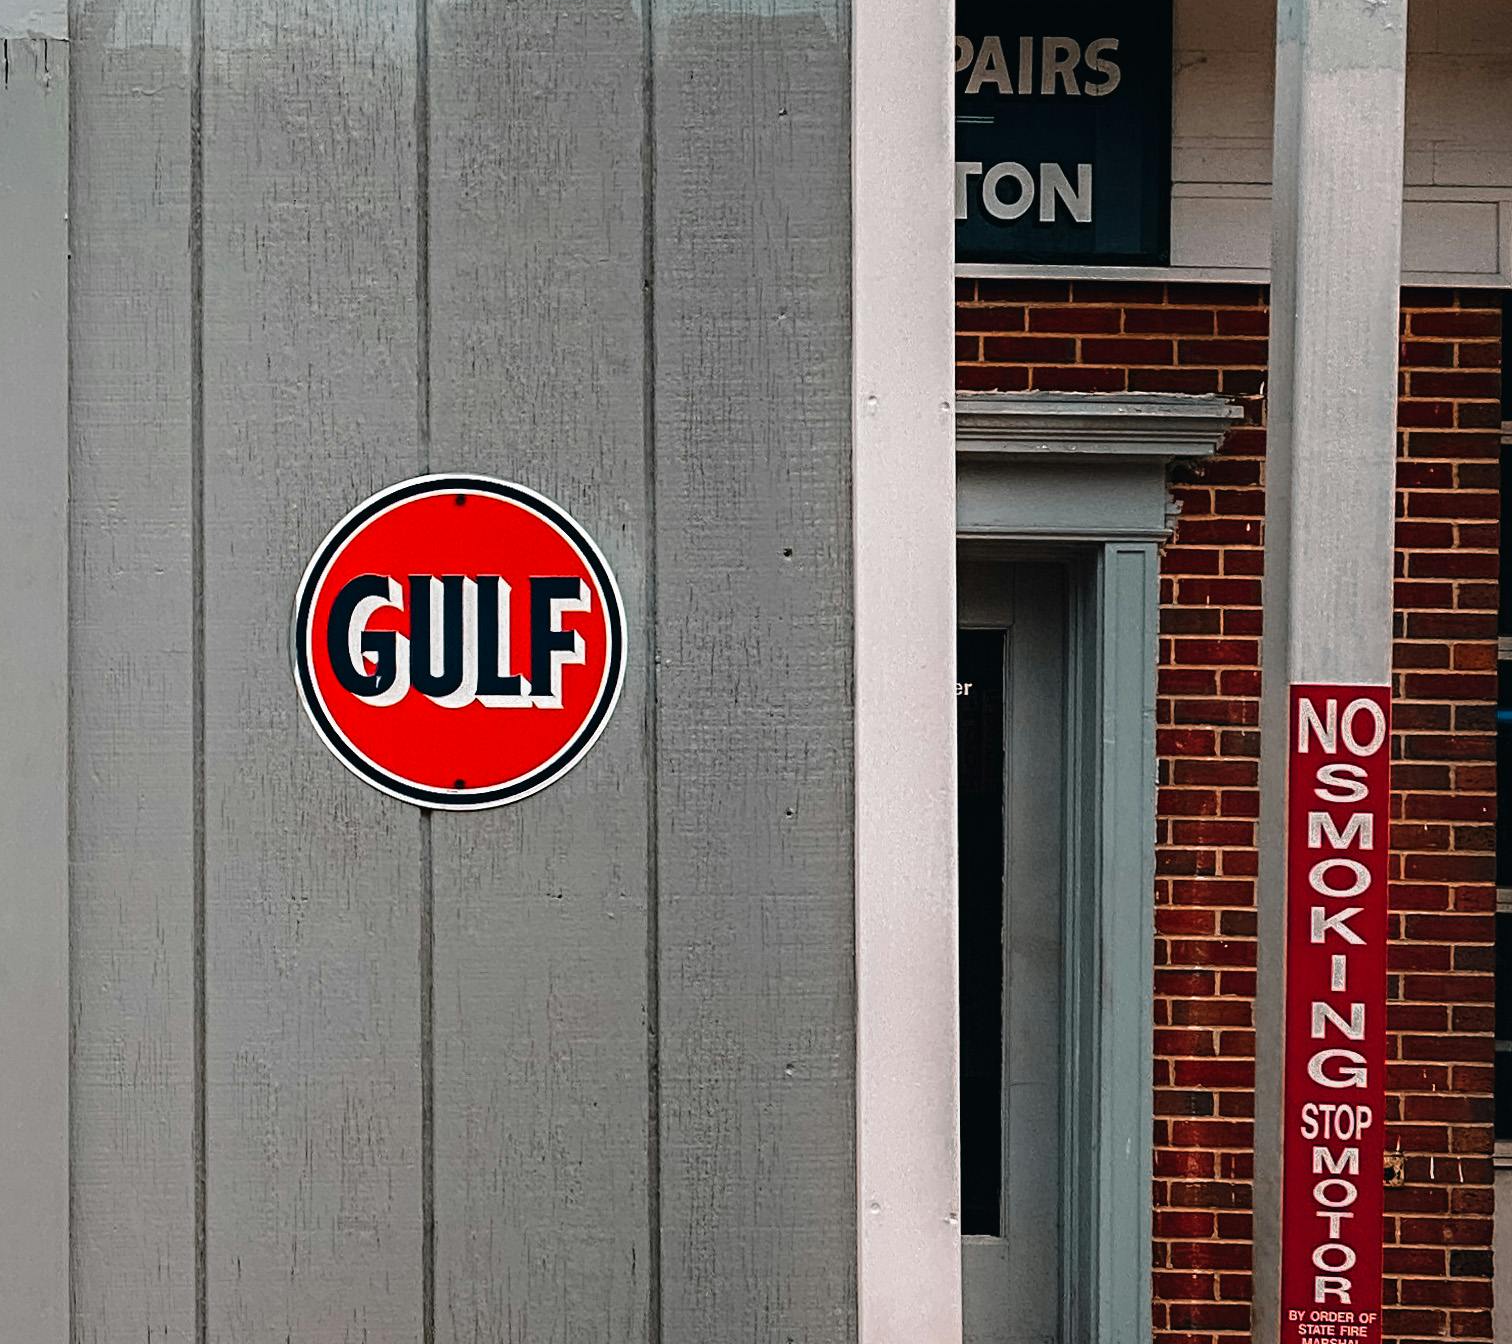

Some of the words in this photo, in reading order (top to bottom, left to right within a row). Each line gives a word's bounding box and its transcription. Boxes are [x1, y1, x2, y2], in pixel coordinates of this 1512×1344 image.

[955, 35, 1121, 96] PAIRS
[327, 573, 592, 709] GULF
[1298, 697, 1386, 757] NO
[1307, 763, 1374, 1089] SMOKING
[1300, 1103, 1372, 1141] STOP
[1311, 1146, 1359, 1304] MOTOR
[1288, 1309, 1305, 1322] BY
[1310, 1310, 1354, 1324] ORDER
[1358, 1312, 1377, 1324] OF
[1298, 1323, 1335, 1336] STATE
[1339, 1325, 1368, 1338] FIRE
